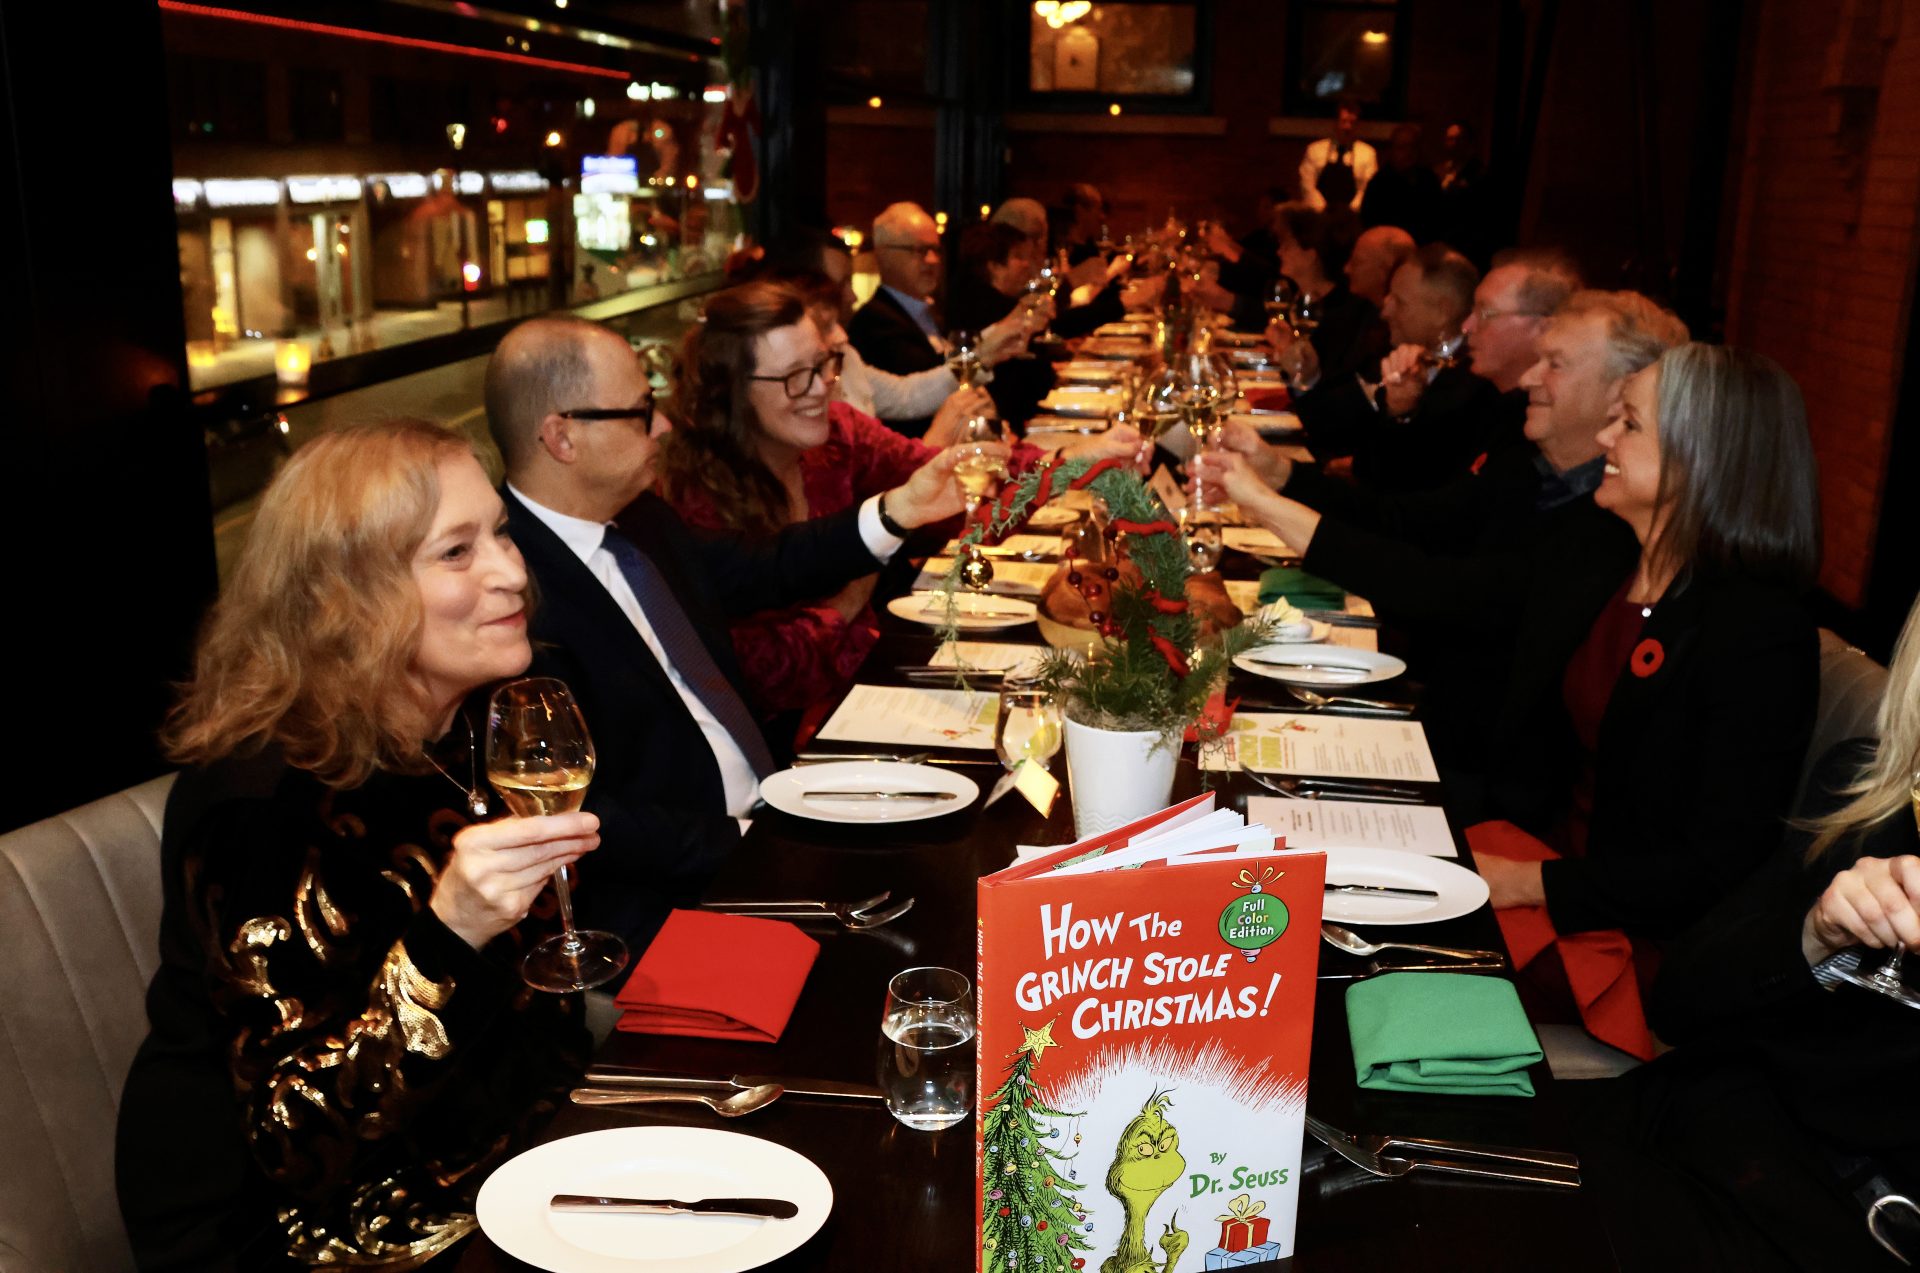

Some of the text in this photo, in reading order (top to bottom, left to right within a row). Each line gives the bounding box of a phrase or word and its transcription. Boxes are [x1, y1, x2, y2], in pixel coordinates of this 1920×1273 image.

[1243, 899, 1265, 913] Full
[1129, 912, 1182, 942] The
[1237, 912, 1269, 925] Color
[1229, 925, 1275, 939] Edition
[1015, 951, 1233, 1012] GRINCH STOLE
[1071, 972, 1282, 1040] CHRISTMAS!
[1209, 1152, 1227, 1166] By
[1189, 1166, 1289, 1199] Dr. Seuss
